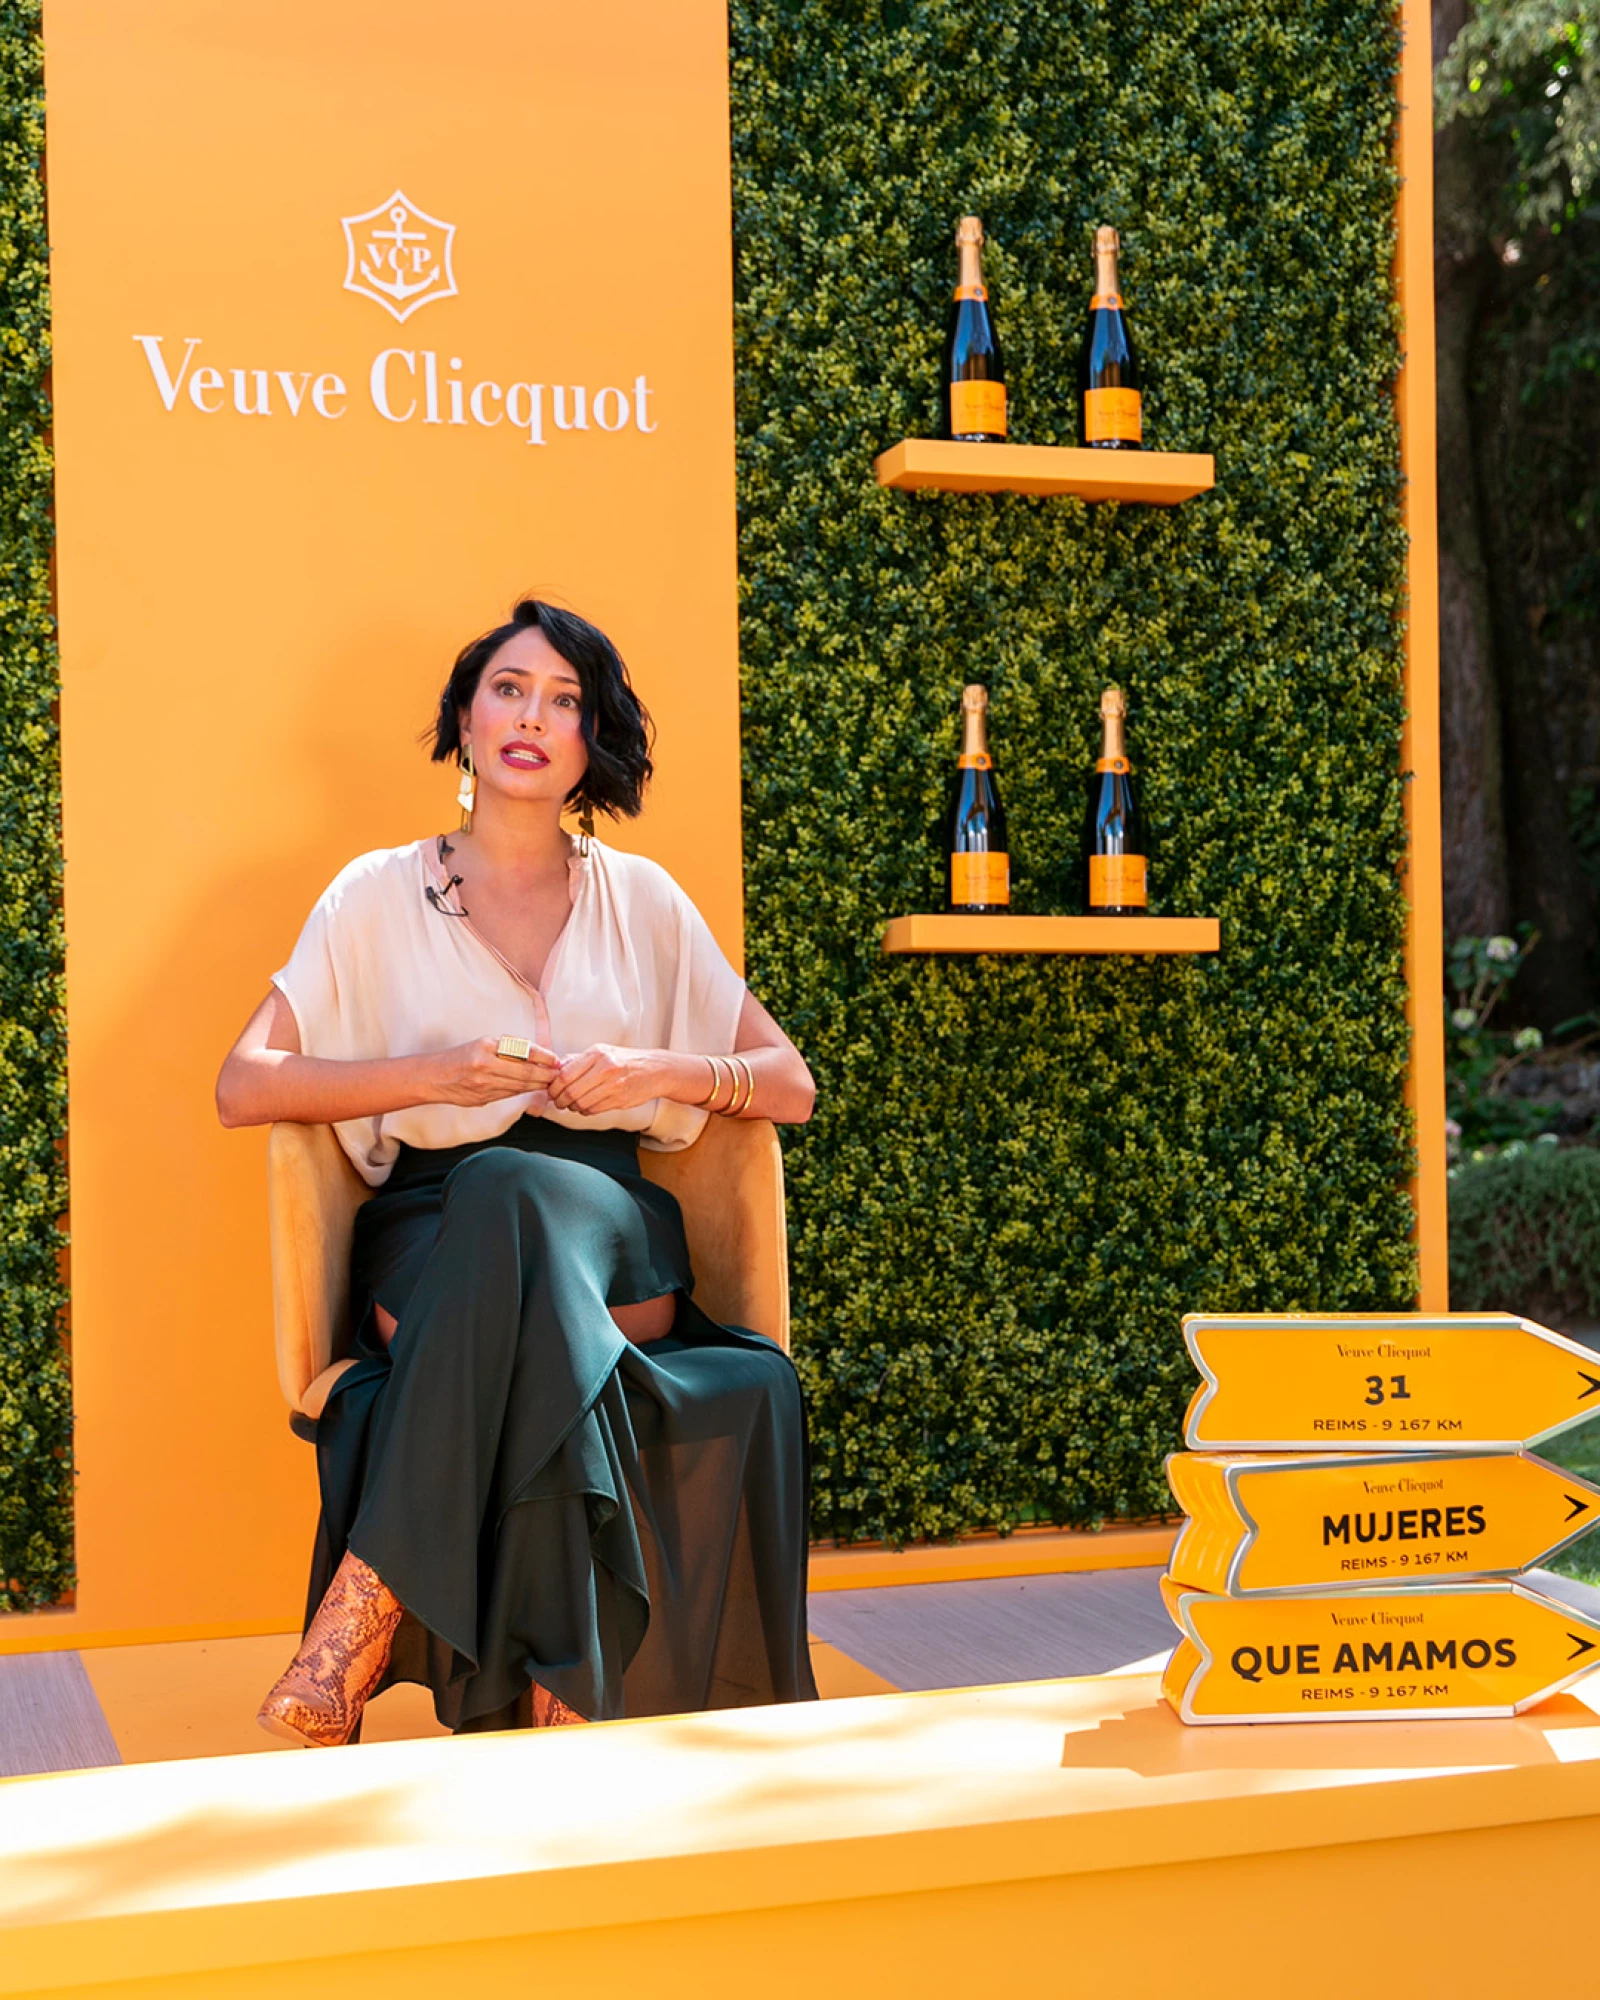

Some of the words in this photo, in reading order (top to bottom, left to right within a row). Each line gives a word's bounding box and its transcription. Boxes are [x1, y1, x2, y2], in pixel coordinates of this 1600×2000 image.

[366, 244, 432, 273] VCP
[132, 335, 347, 418] Veuve
[370, 348, 658, 445] Clicquot
[1336, 1344, 1374, 1358] Veuve
[1377, 1343, 1431, 1360] Clicquot
[1364, 1375, 1411, 1406] 31
[1313, 1419, 1367, 1431] REIMS
[1399, 1419, 1431, 1431] 167
[1437, 1419, 1463, 1431] KM
[1363, 1480, 1396, 1494] Veuve
[1398, 1477, 1444, 1494] Clicquot
[1323, 1504, 1486, 1546] MUJERES
[1341, 1556, 1388, 1571] REIMS
[1415, 1552, 1441, 1565] 167
[1446, 1550, 1468, 1562] KM
[1330, 1612, 1368, 1626] Veuve
[1371, 1611, 1425, 1627] Clicquot
[1231, 1644, 1320, 1683] QUE
[1332, 1638, 1517, 1674] AMAMOS
[1301, 1687, 1355, 1700] REIMS
[1386, 1685, 1417, 1698] 167
[1423, 1685, 1449, 1696] KM
